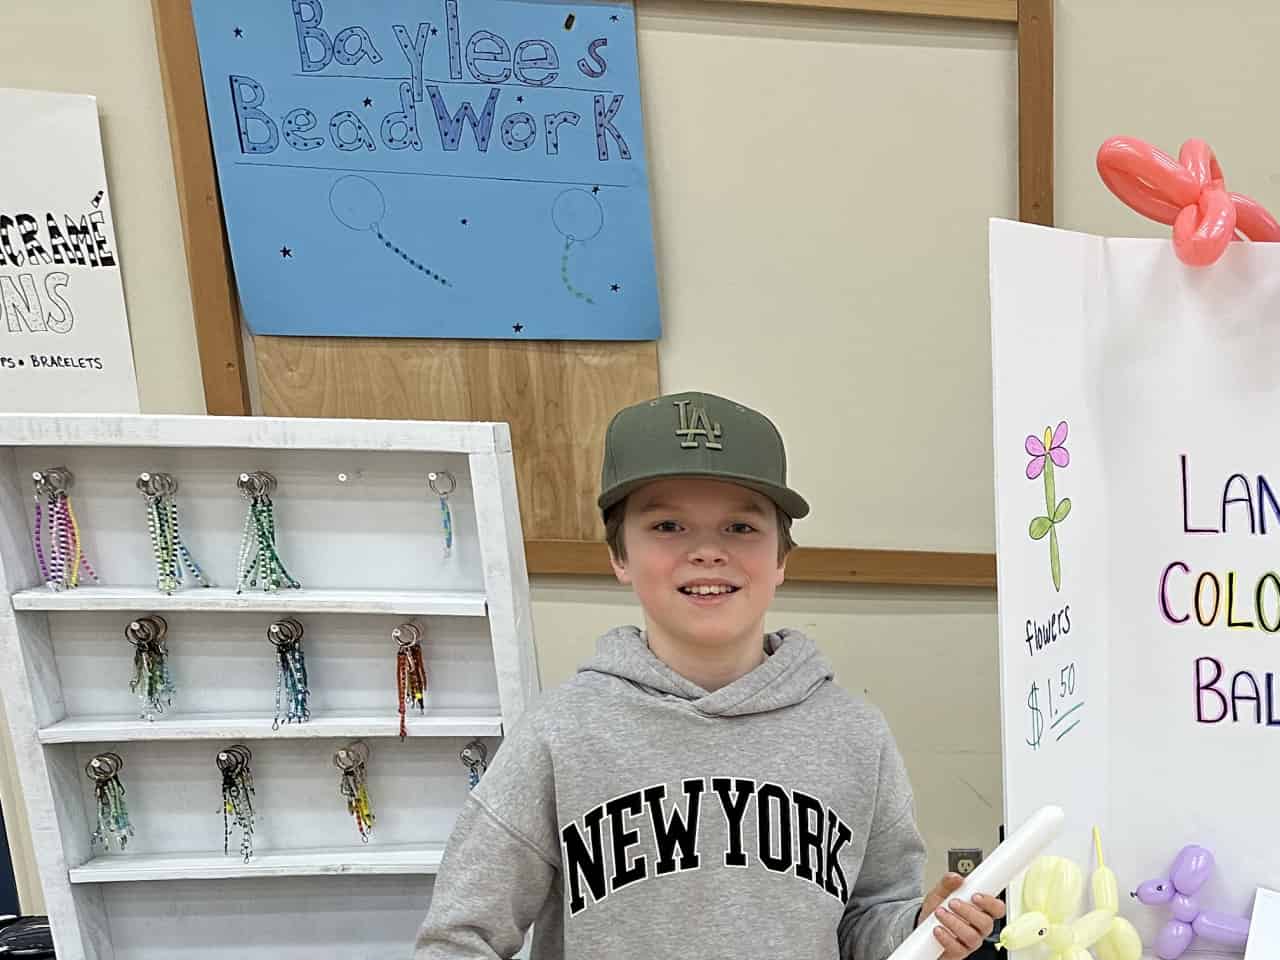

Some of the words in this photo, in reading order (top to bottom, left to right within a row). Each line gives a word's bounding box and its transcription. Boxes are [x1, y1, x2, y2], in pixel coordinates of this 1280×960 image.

[0, 191, 116, 267] CRAMÉ
[0, 271, 74, 334] NS
[31, 354, 104, 370] BRACELETS
[673, 400, 722, 449] LA
[1025, 604, 1072, 657] flowers
[1025, 662, 1077, 751] $1.50
[560, 776, 706, 918] NEW
[710, 775, 854, 905] YORK
